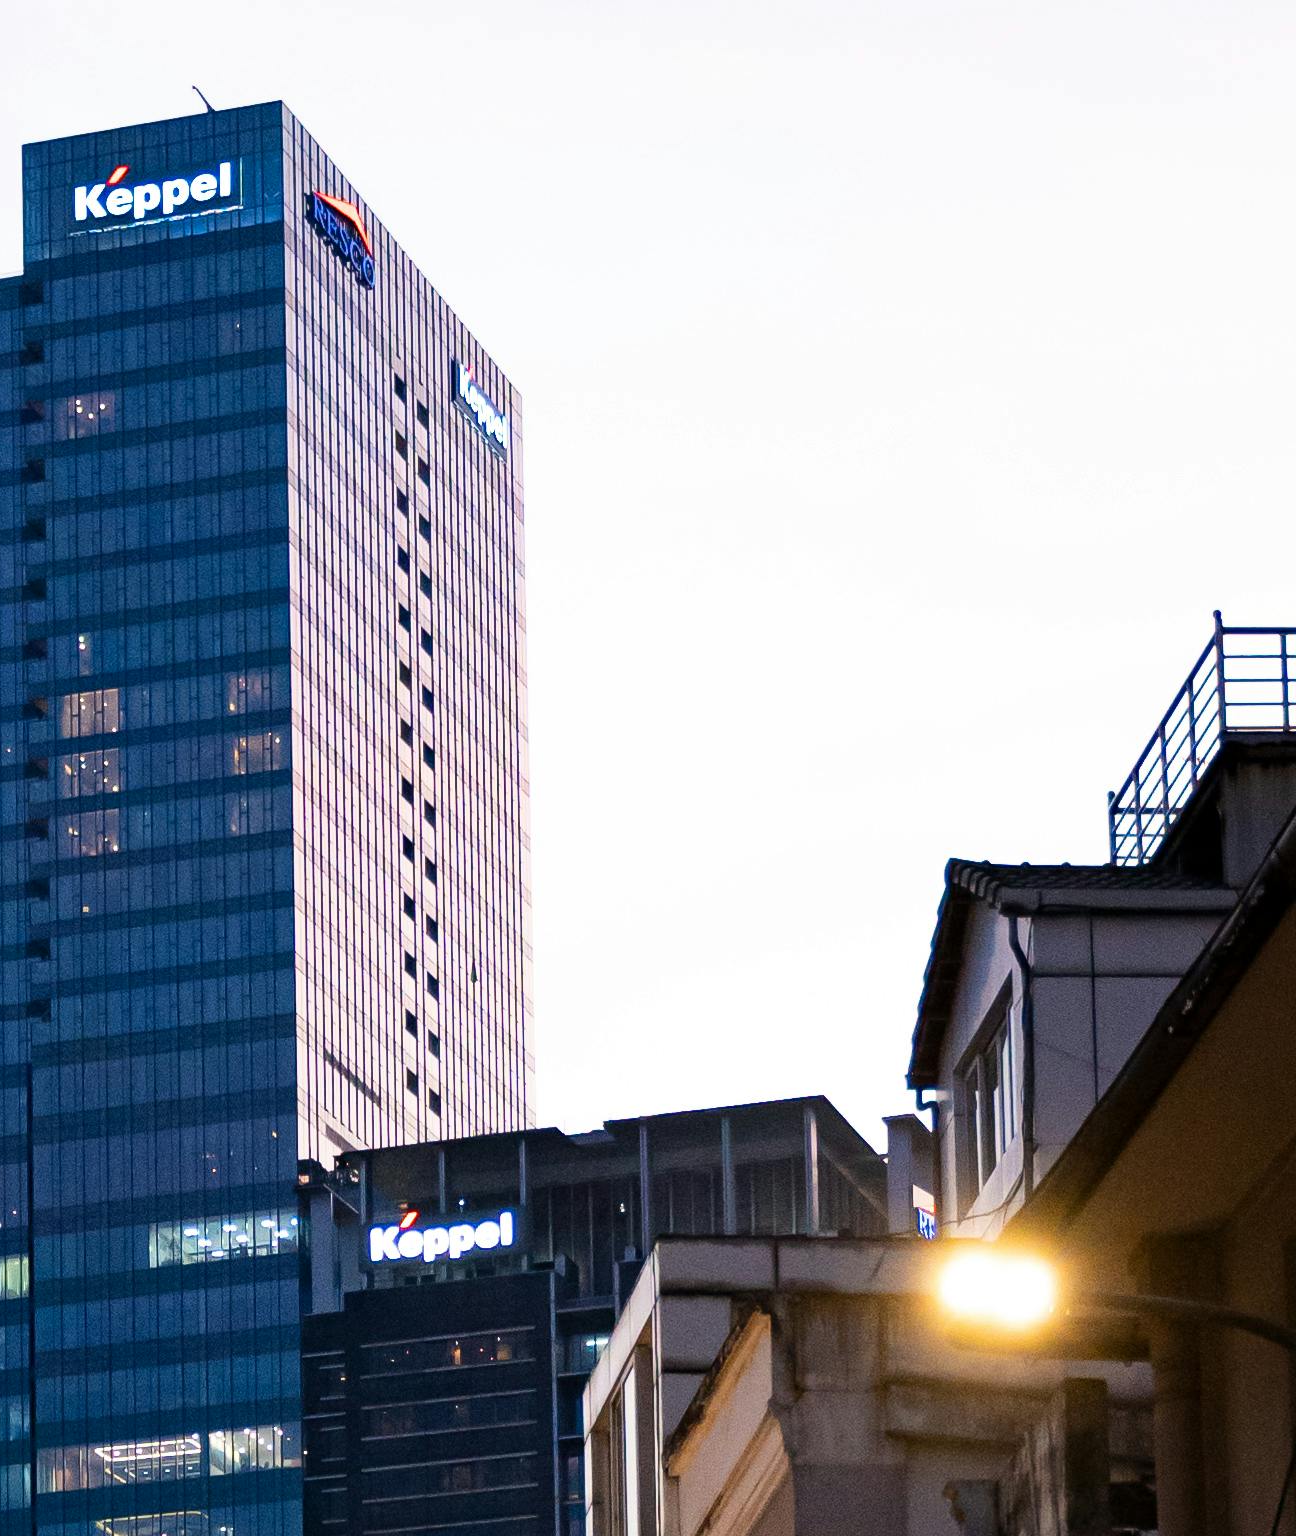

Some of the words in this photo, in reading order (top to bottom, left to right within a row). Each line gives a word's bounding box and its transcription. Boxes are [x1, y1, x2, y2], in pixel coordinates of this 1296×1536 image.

[73, 164, 232, 222] Keppel
[313, 191, 377, 289] RESCO
[369, 1211, 514, 1263] Keppel
